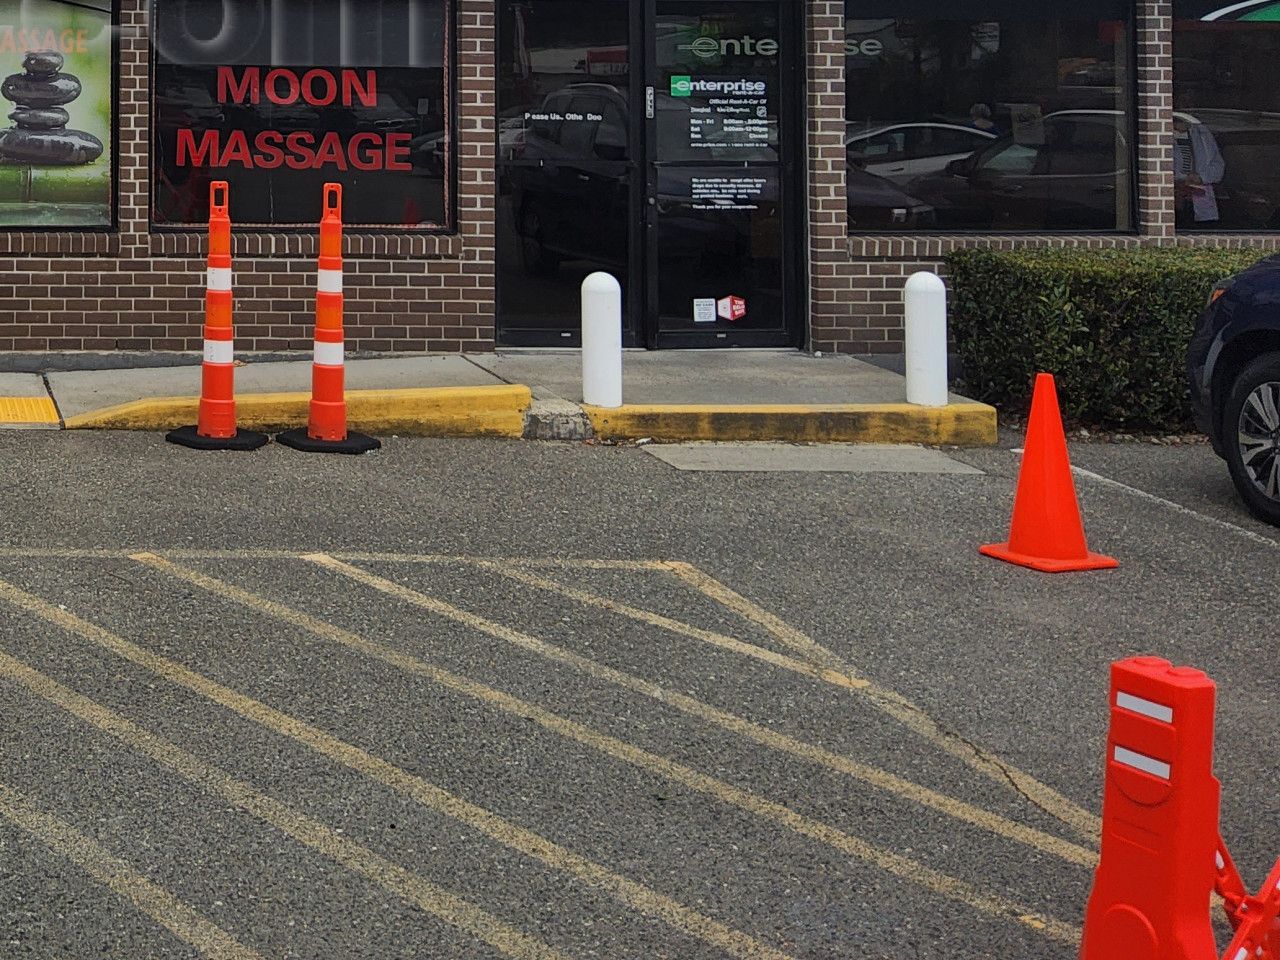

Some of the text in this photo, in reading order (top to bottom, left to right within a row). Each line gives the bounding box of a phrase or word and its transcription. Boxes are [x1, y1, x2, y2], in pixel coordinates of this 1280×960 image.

[216, 65, 379, 108] MOON
[671, 79, 766, 94] enterprise
[175, 128, 414, 171] MASSAGE
